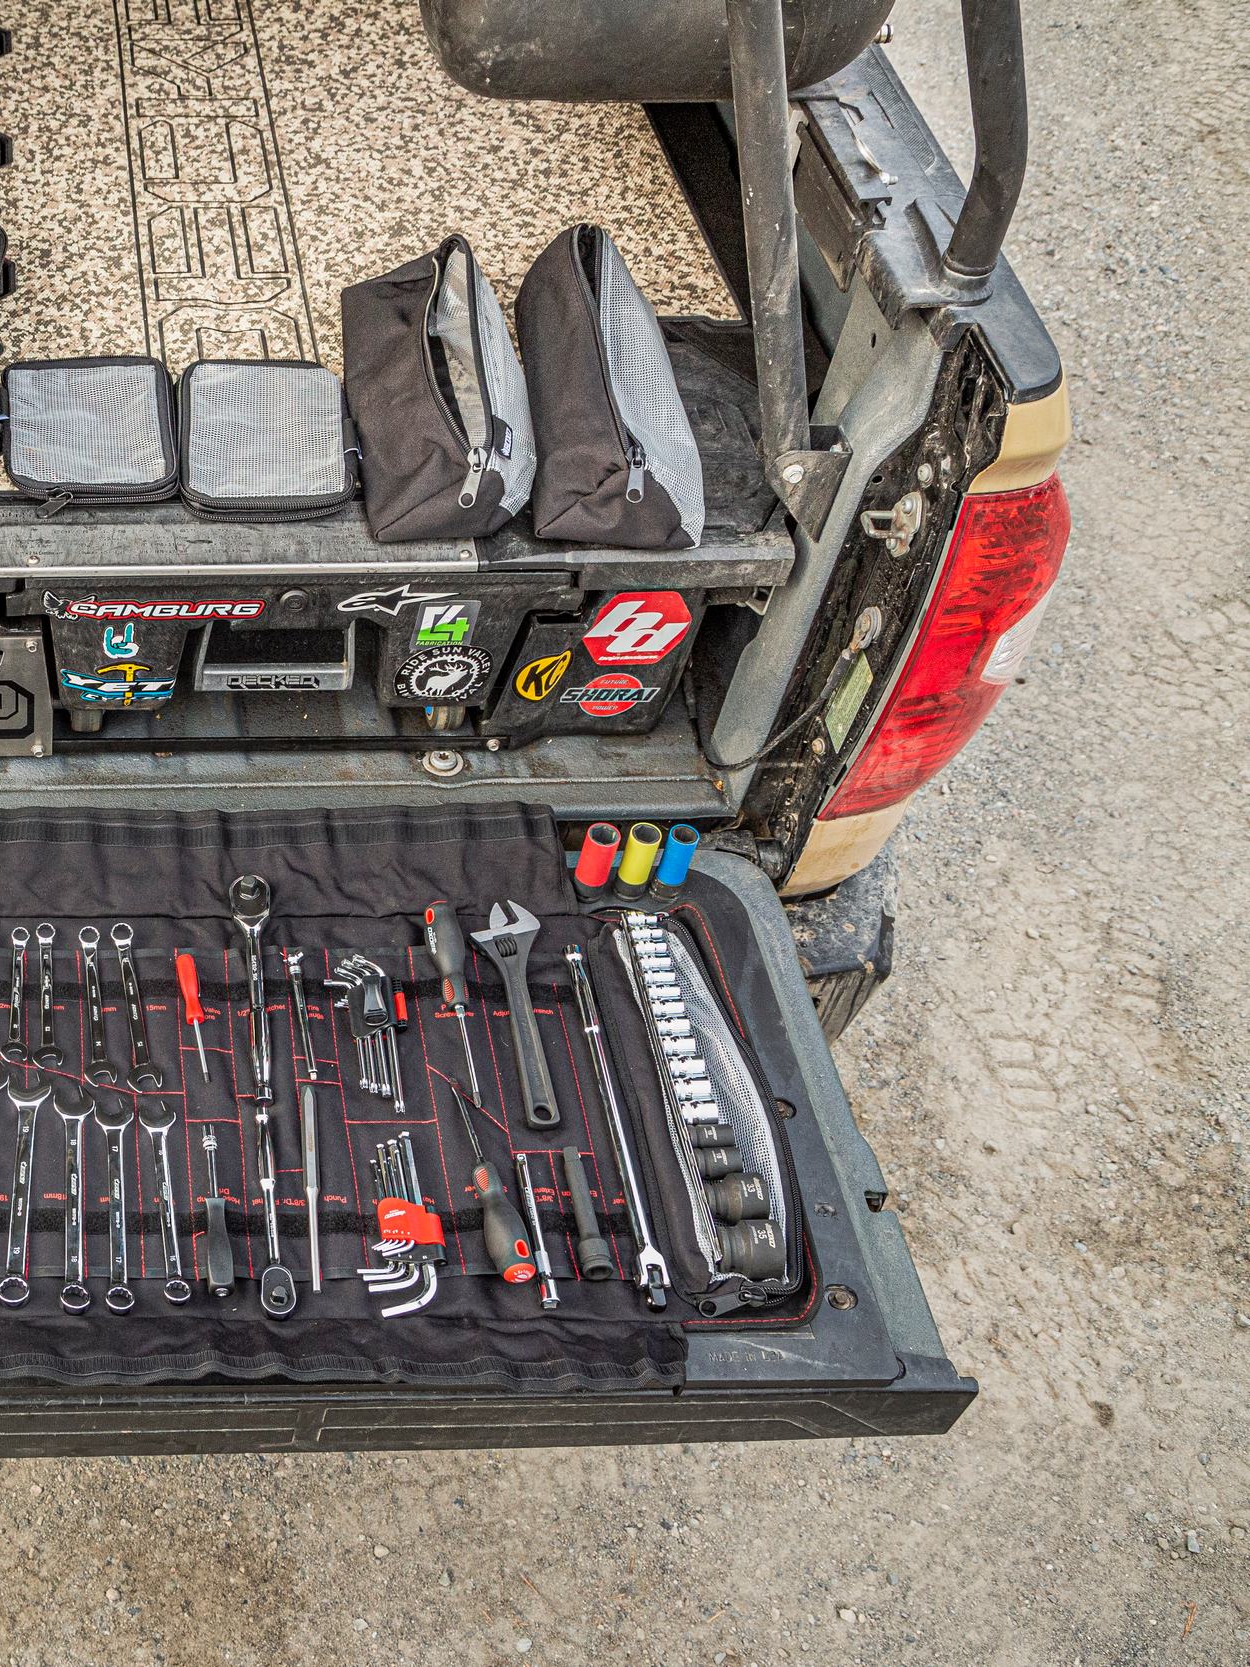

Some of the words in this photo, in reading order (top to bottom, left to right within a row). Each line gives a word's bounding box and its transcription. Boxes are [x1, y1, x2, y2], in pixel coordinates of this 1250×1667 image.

[70, 602, 262, 617] CAMBURG
[401, 653, 428, 676] RIDE
[432, 646, 462, 656] SUN
[468, 648, 491, 674] VALLEY
[226, 674, 320, 689] DECKED
[561, 688, 659, 702] SHORAI
[746, 1182, 756, 1193] 33
[323, 1195, 347, 1204] Punch
[758, 1229, 767, 1240] 35
[13, 1247, 21, 1255] 19
[115, 1256, 122, 1264] 17
